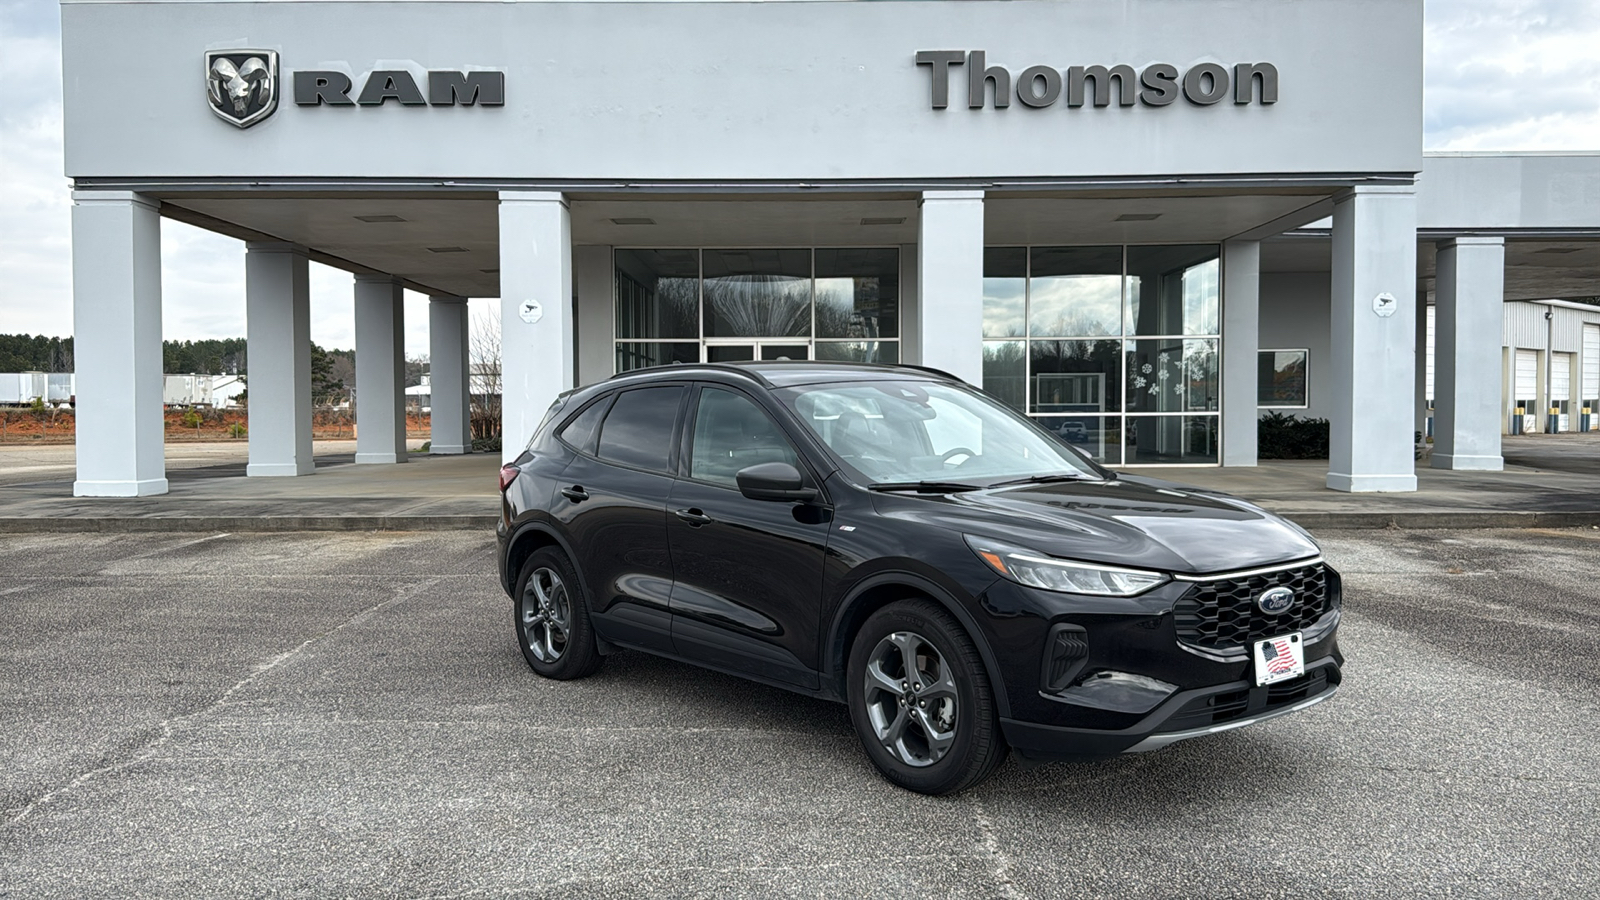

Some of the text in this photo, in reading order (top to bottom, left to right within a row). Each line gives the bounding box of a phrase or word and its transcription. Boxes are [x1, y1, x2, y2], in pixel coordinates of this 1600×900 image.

[293, 70, 505, 106] RAM
[916, 50, 1278, 109] Thomson
[1268, 593, 1289, 609] Ford
